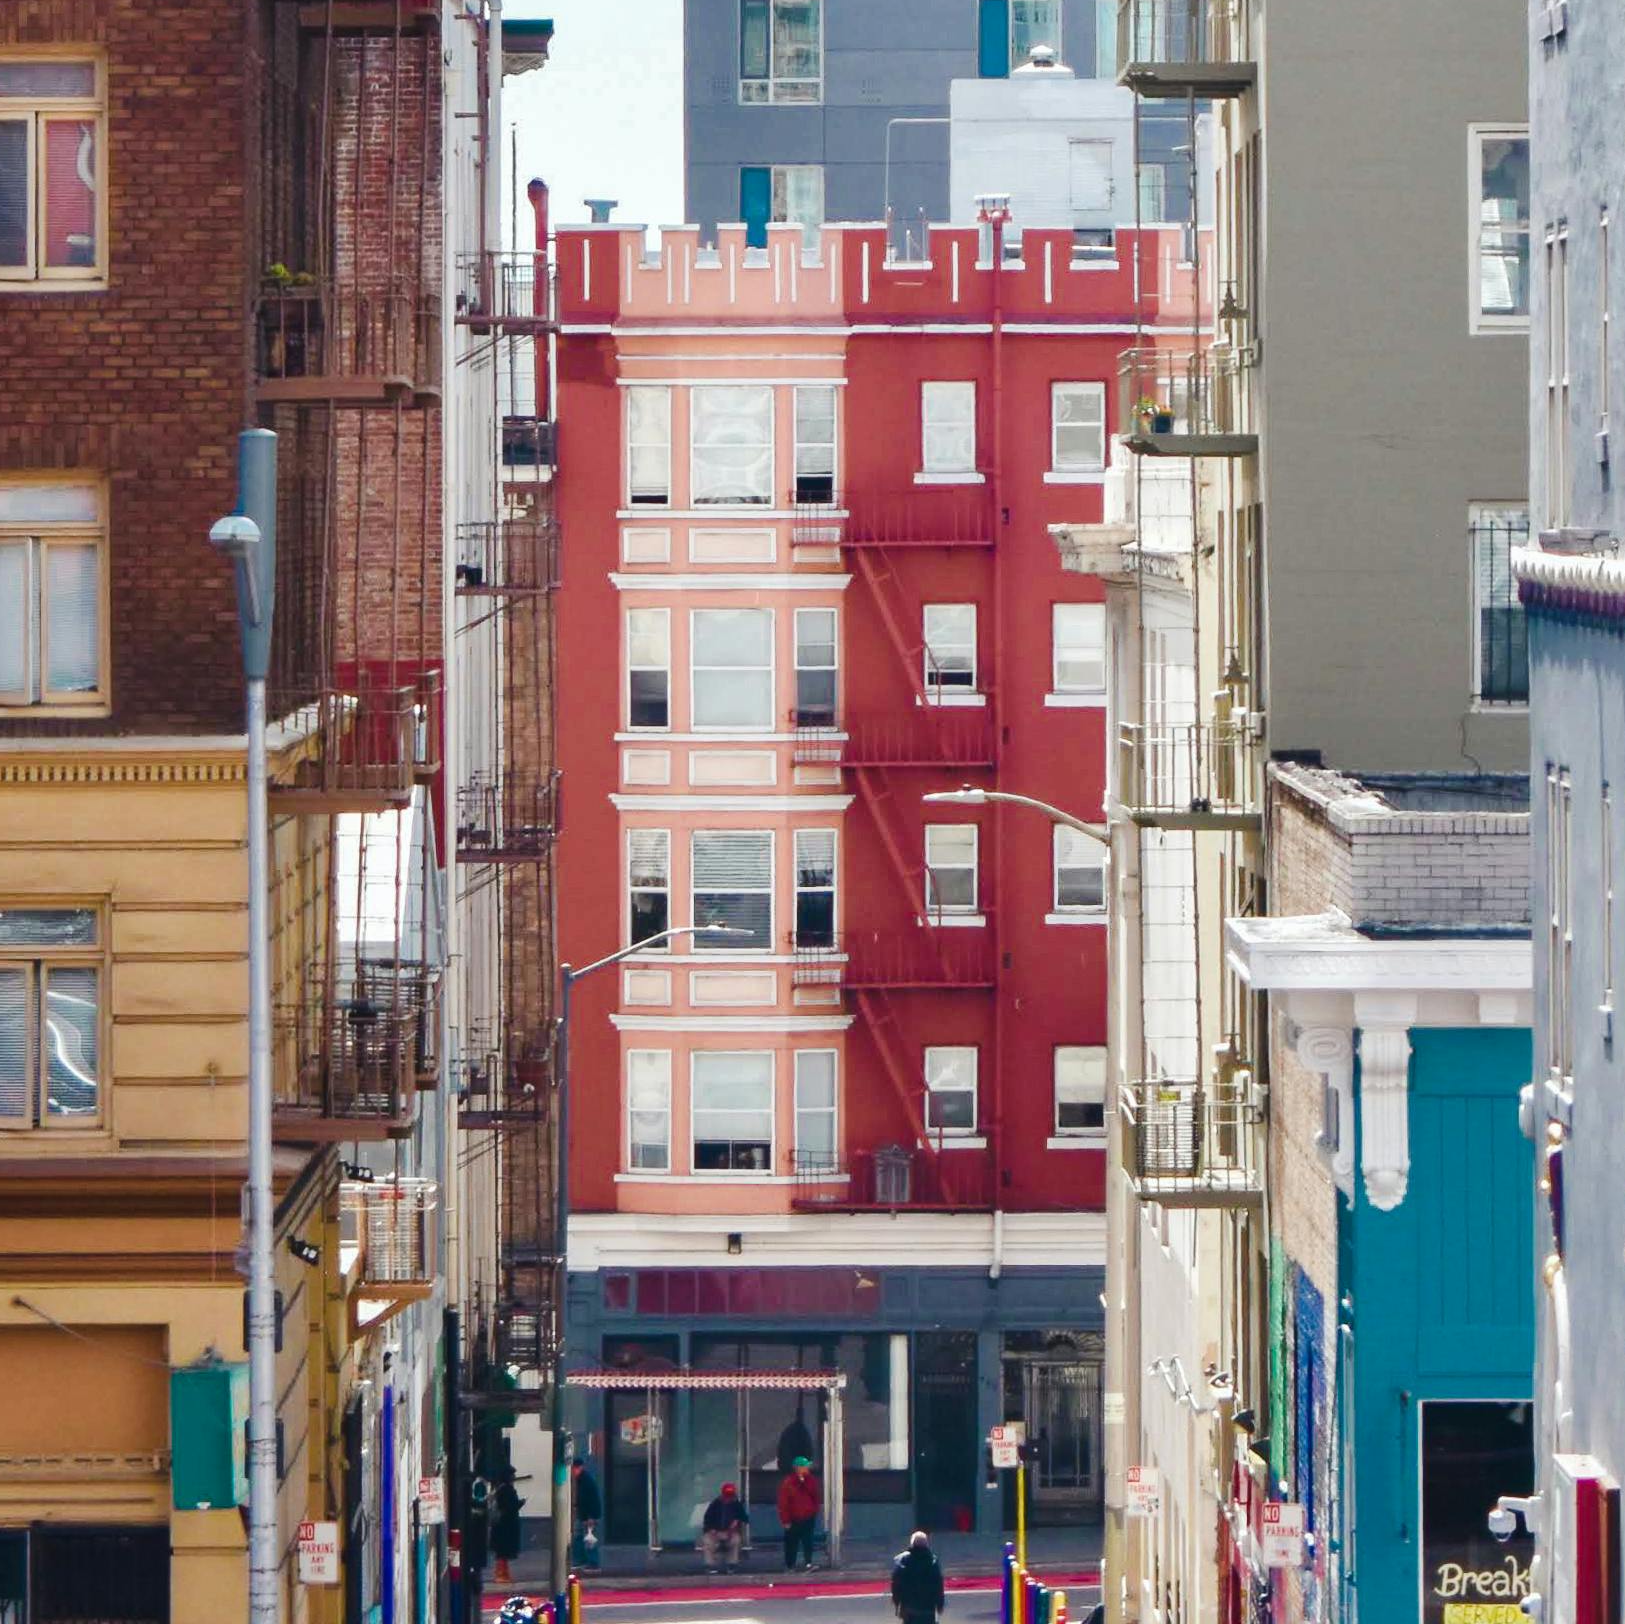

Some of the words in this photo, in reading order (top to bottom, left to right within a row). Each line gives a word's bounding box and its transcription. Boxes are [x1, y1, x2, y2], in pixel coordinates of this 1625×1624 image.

[1264, 1506, 1279, 1521] NO
[299, 1525, 314, 1539] NO
[1265, 1525, 1300, 1537] PARKING
[302, 1544, 334, 1553] PARKING
[1451, 1605, 1517, 1624] SERVED
